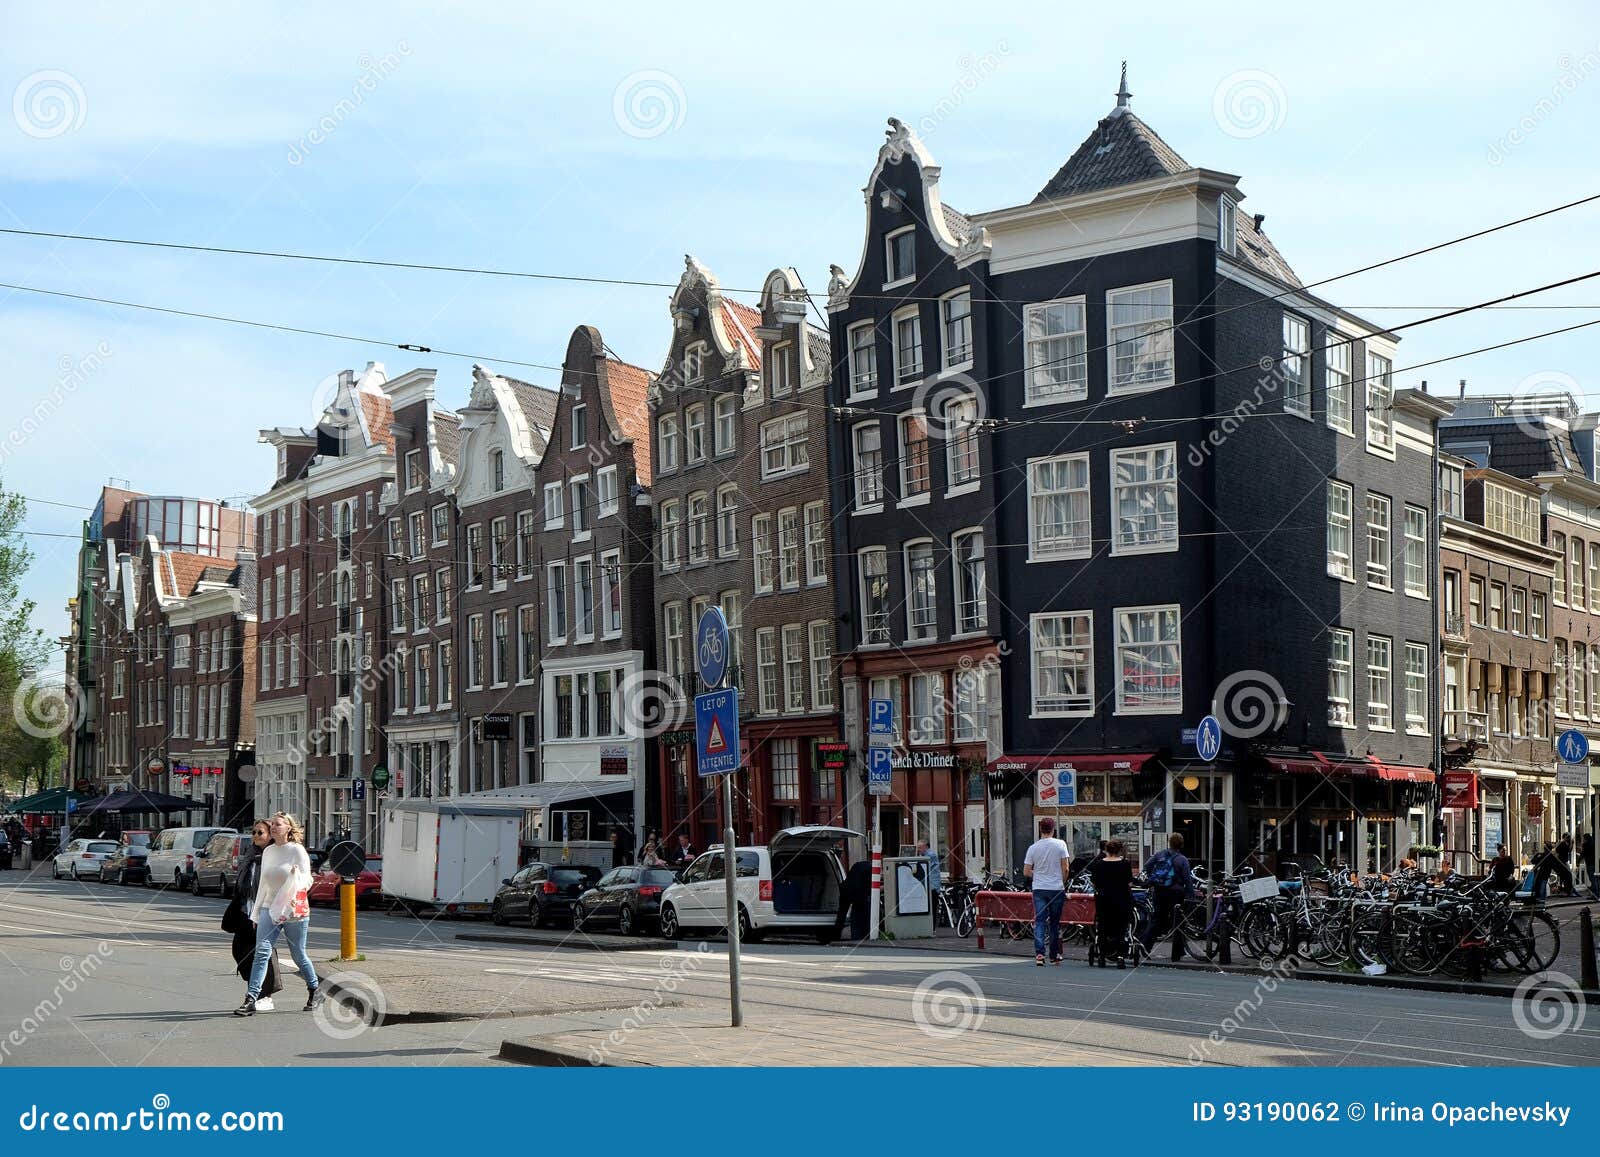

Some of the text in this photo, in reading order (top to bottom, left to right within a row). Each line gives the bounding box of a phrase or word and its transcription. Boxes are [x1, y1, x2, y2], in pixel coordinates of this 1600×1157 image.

[702, 696, 726, 711] LET OP
[875, 702, 887, 720] P
[701, 754, 734, 770] ATTENTIE
[874, 750, 887, 768] P
[891, 753, 912, 768] unch
[921, 752, 953, 768] Dinner
[871, 771, 890, 780] taxi
[355, 781, 363, 791] P
